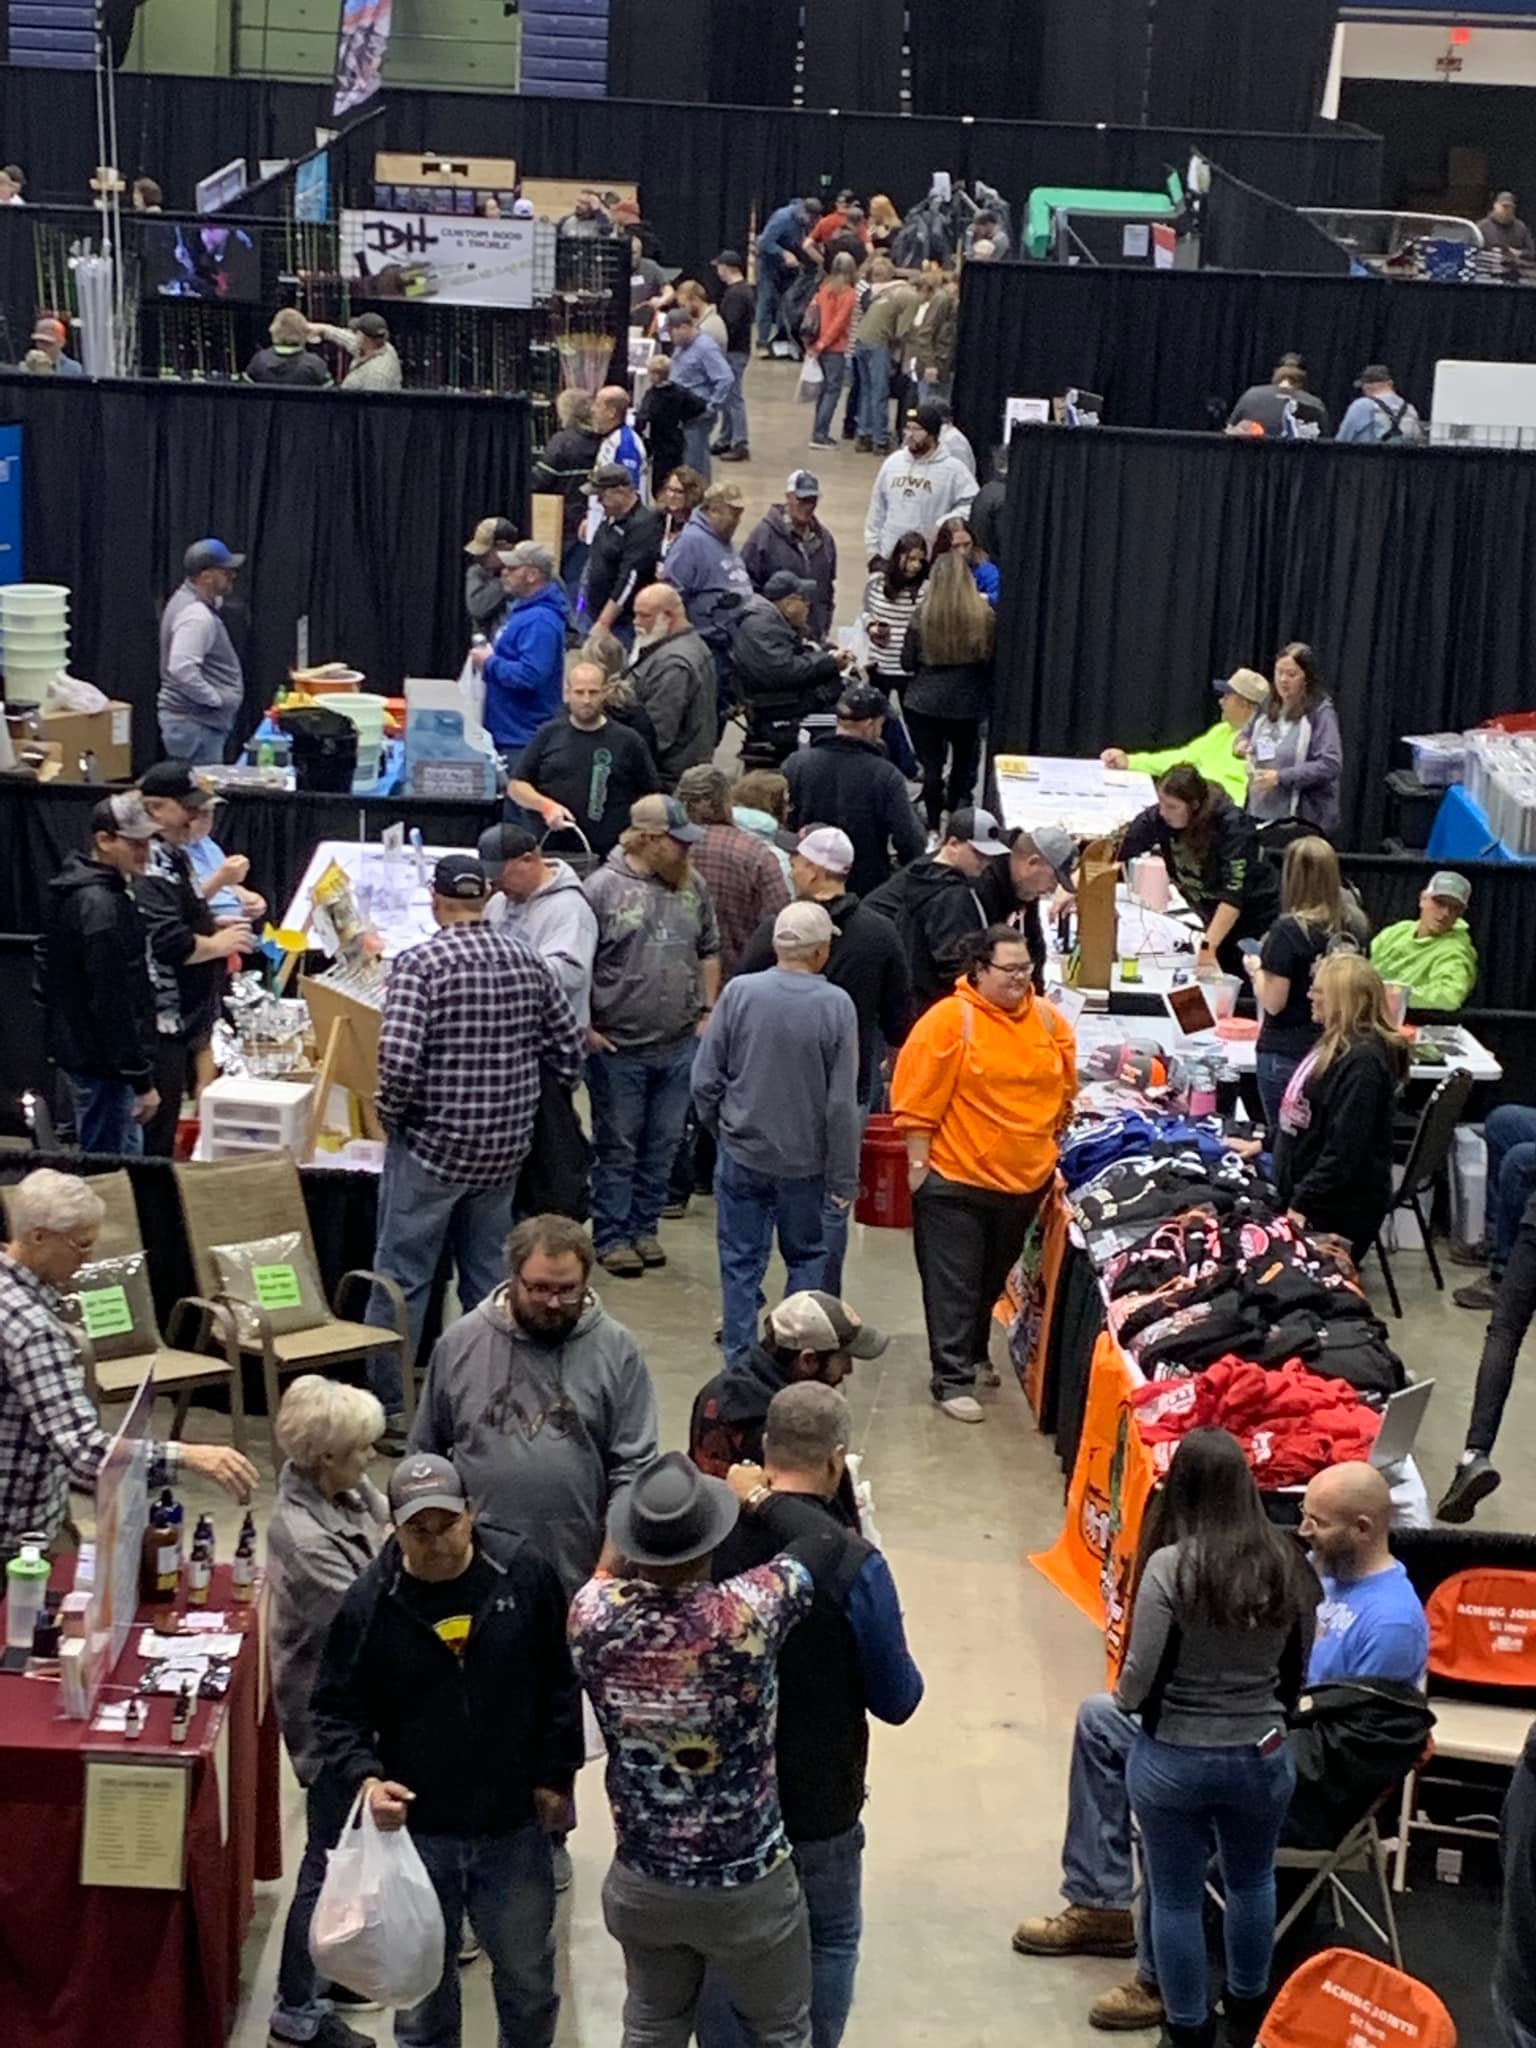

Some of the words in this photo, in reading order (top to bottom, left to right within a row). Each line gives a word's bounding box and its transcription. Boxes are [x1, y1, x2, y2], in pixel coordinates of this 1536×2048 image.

[441, 227, 489, 240] CUSTOM
[492, 230, 522, 241] RODS
[891, 475, 933, 495] IOWA
[1457, 1603, 1506, 1617] ACHING
[1321, 1980, 1372, 2013] ACHING
